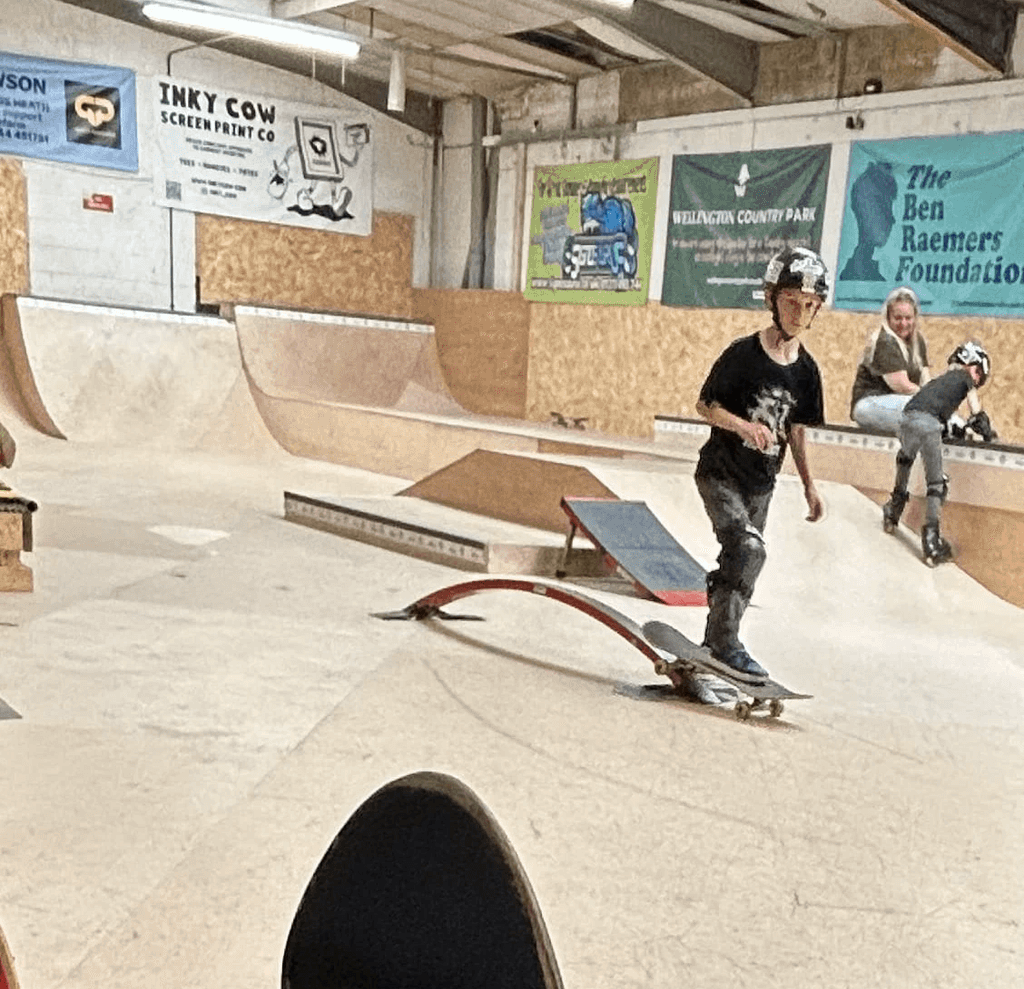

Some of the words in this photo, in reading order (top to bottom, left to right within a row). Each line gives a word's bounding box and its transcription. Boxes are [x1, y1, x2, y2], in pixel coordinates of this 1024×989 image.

[159, 82, 217, 114] INKY
[225, 97, 276, 125] COW
[160, 110, 211, 132] SCREEN
[214, 120, 254, 139] PRINT
[257, 128, 275, 142] CO
[906, 164, 951, 191] The
[672, 210, 735, 225] WELLINGTON
[737, 209, 784, 224] COUNTRY
[785, 207, 816, 222] PARK
[902, 193, 944, 221] Ben
[901, 225, 1003, 252] Raemers
